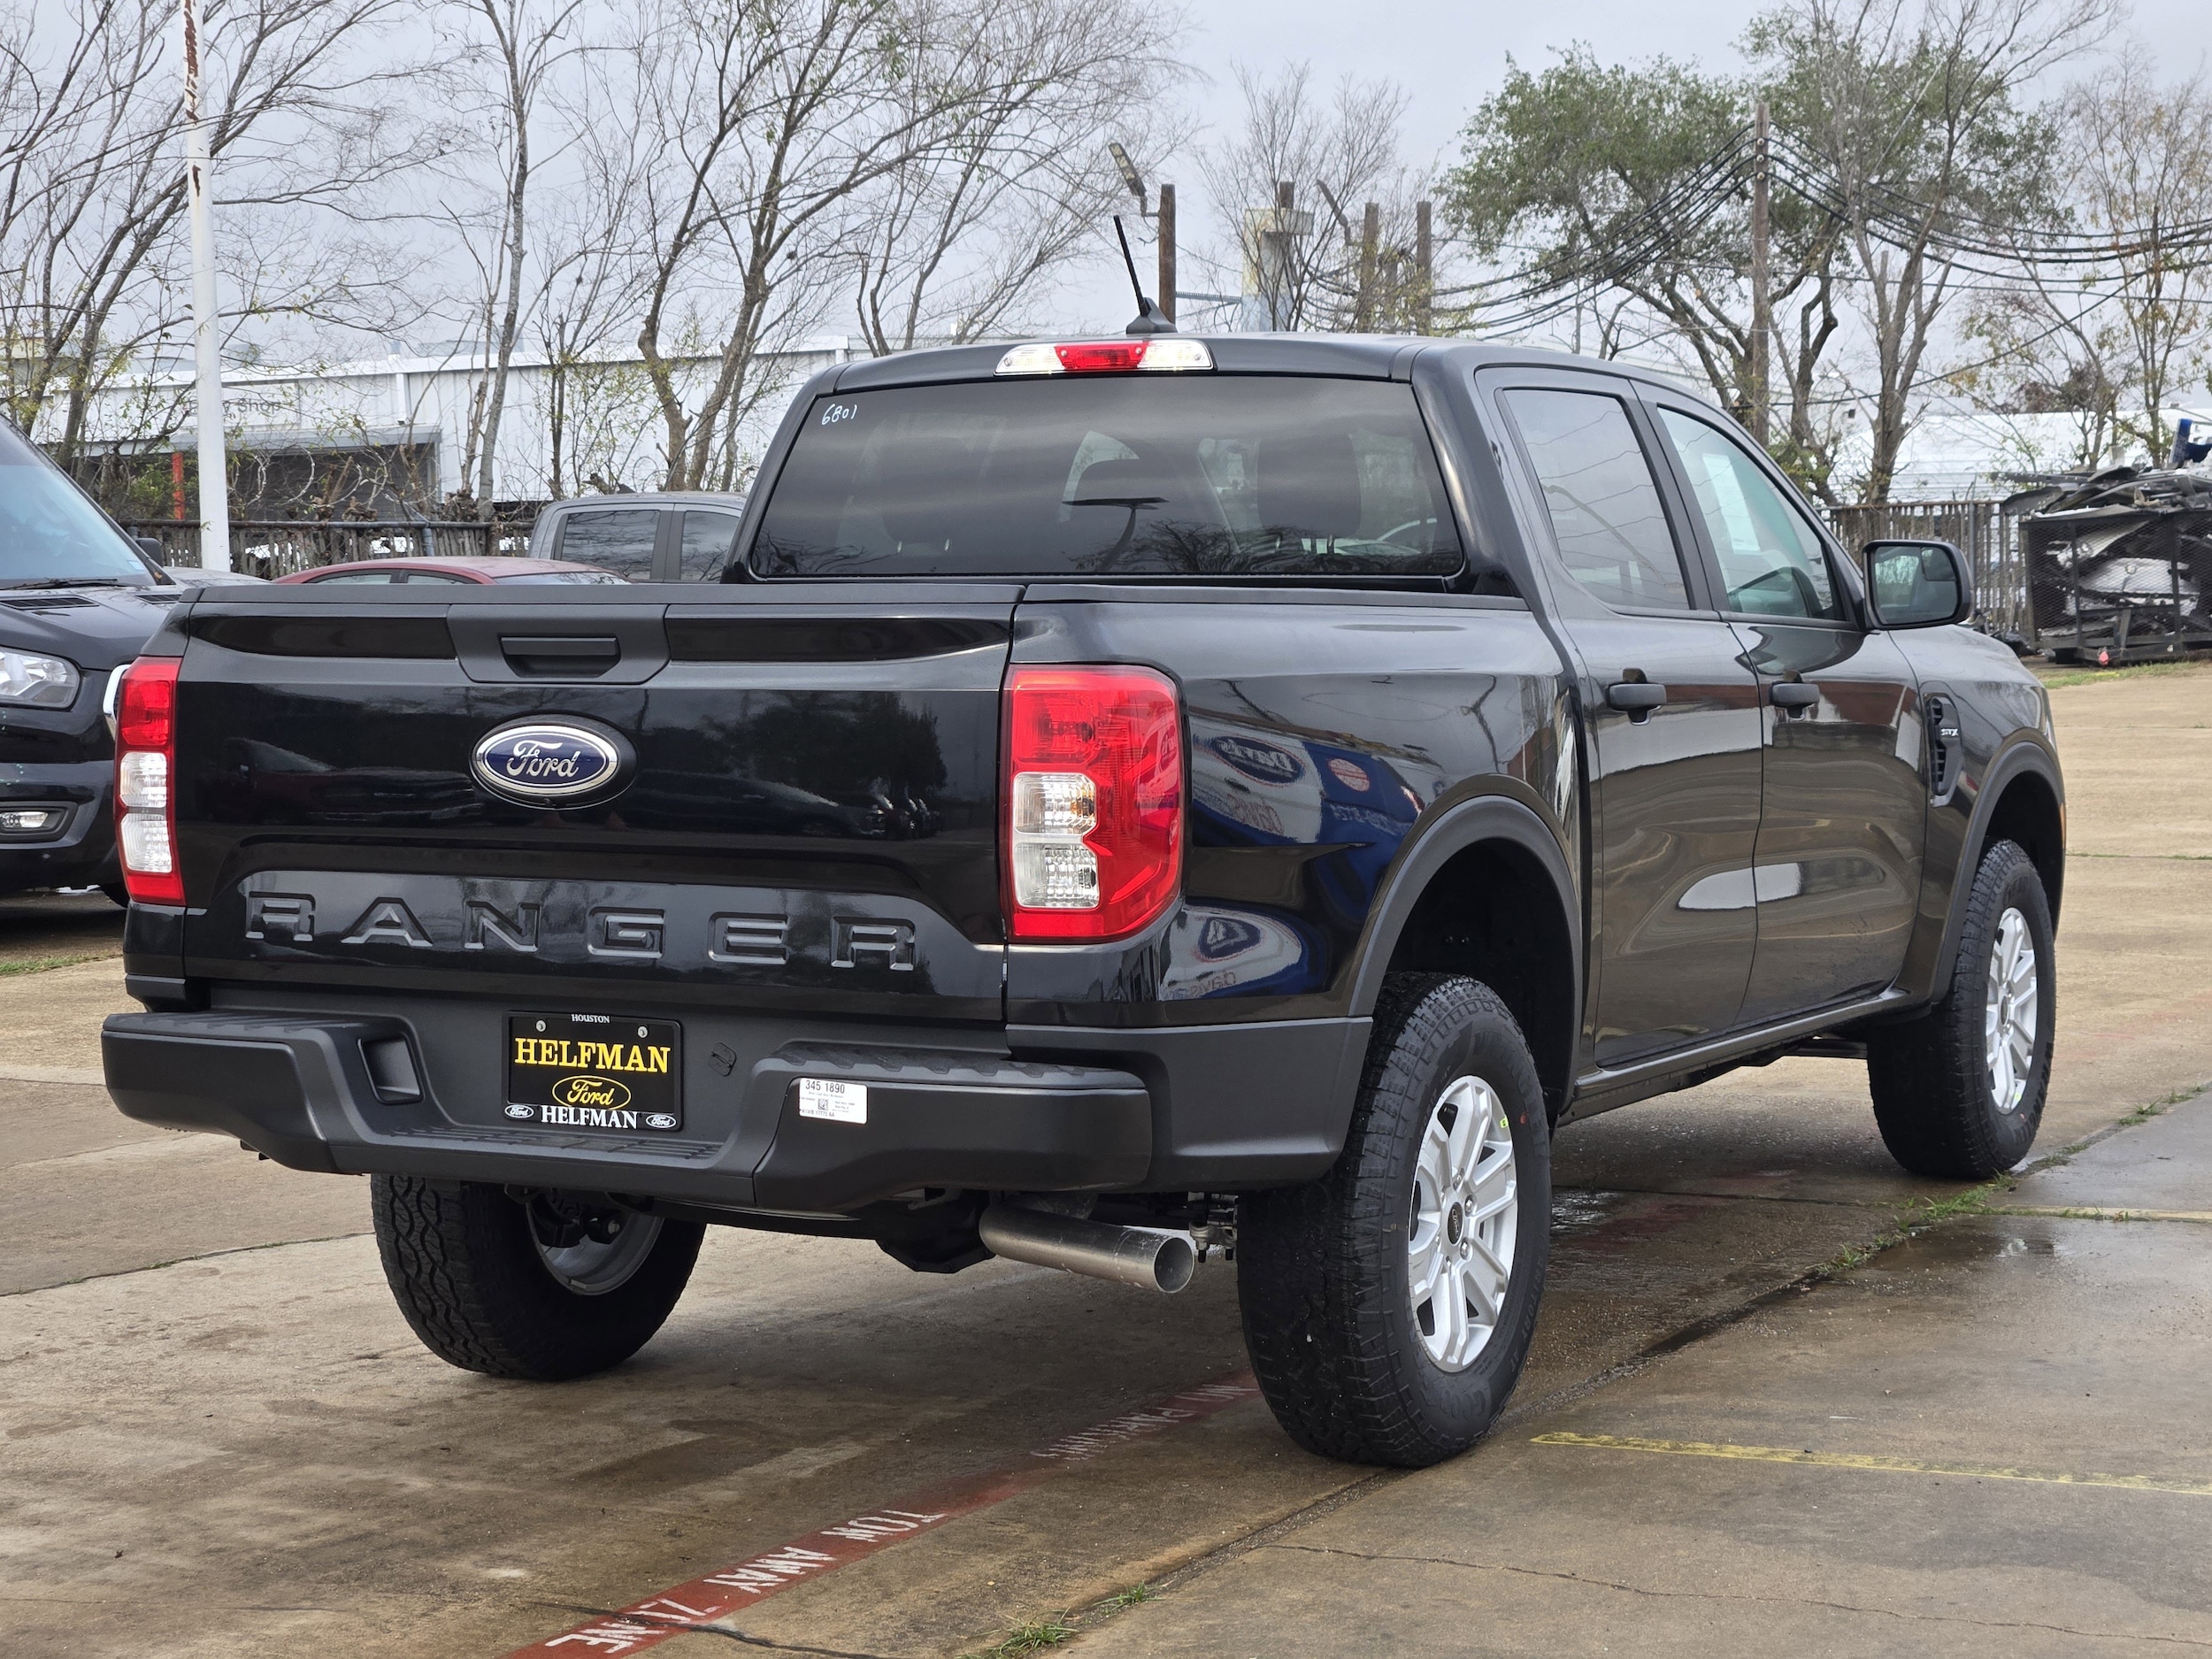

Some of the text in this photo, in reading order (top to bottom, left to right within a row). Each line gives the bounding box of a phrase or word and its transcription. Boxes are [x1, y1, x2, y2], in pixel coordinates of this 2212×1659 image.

[821, 403, 858, 425] 6801
[506, 740, 581, 778] Ford
[245, 891, 916, 972] RANGER
[571, 1014, 611, 1024] HOUSTON
[515, 1038, 671, 1073] HELFMAN
[566, 1079, 615, 1105] Ford
[805, 1079, 845, 1094] 345 1890
[509, 1106, 529, 1116] Ford
[541, 1105, 638, 1129] HELFMAN
[650, 1116, 672, 1126] Ford
[820, 1509, 948, 1542] TOW
[703, 1545, 837, 1594] AWAY
